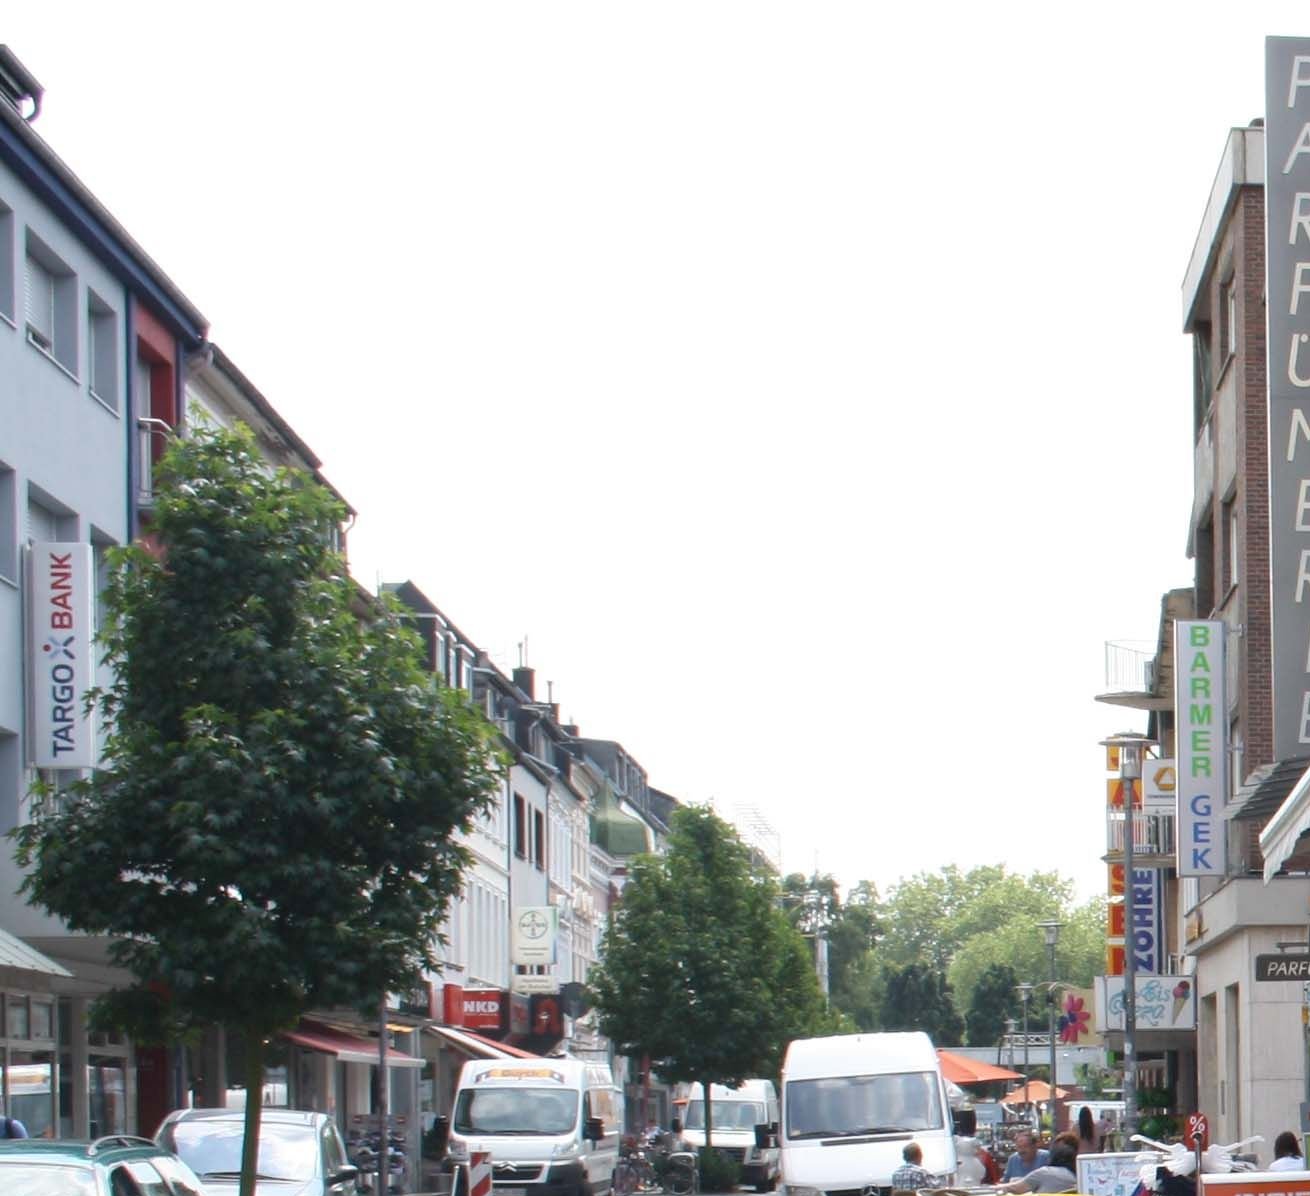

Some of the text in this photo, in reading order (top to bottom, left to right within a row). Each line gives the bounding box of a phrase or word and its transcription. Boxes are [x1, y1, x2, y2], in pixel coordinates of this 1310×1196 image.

[50, 552, 75, 757] TARGO BANK
[1189, 625, 1212, 869] BARMER GEK
[464, 1000, 500, 1013] NKD
